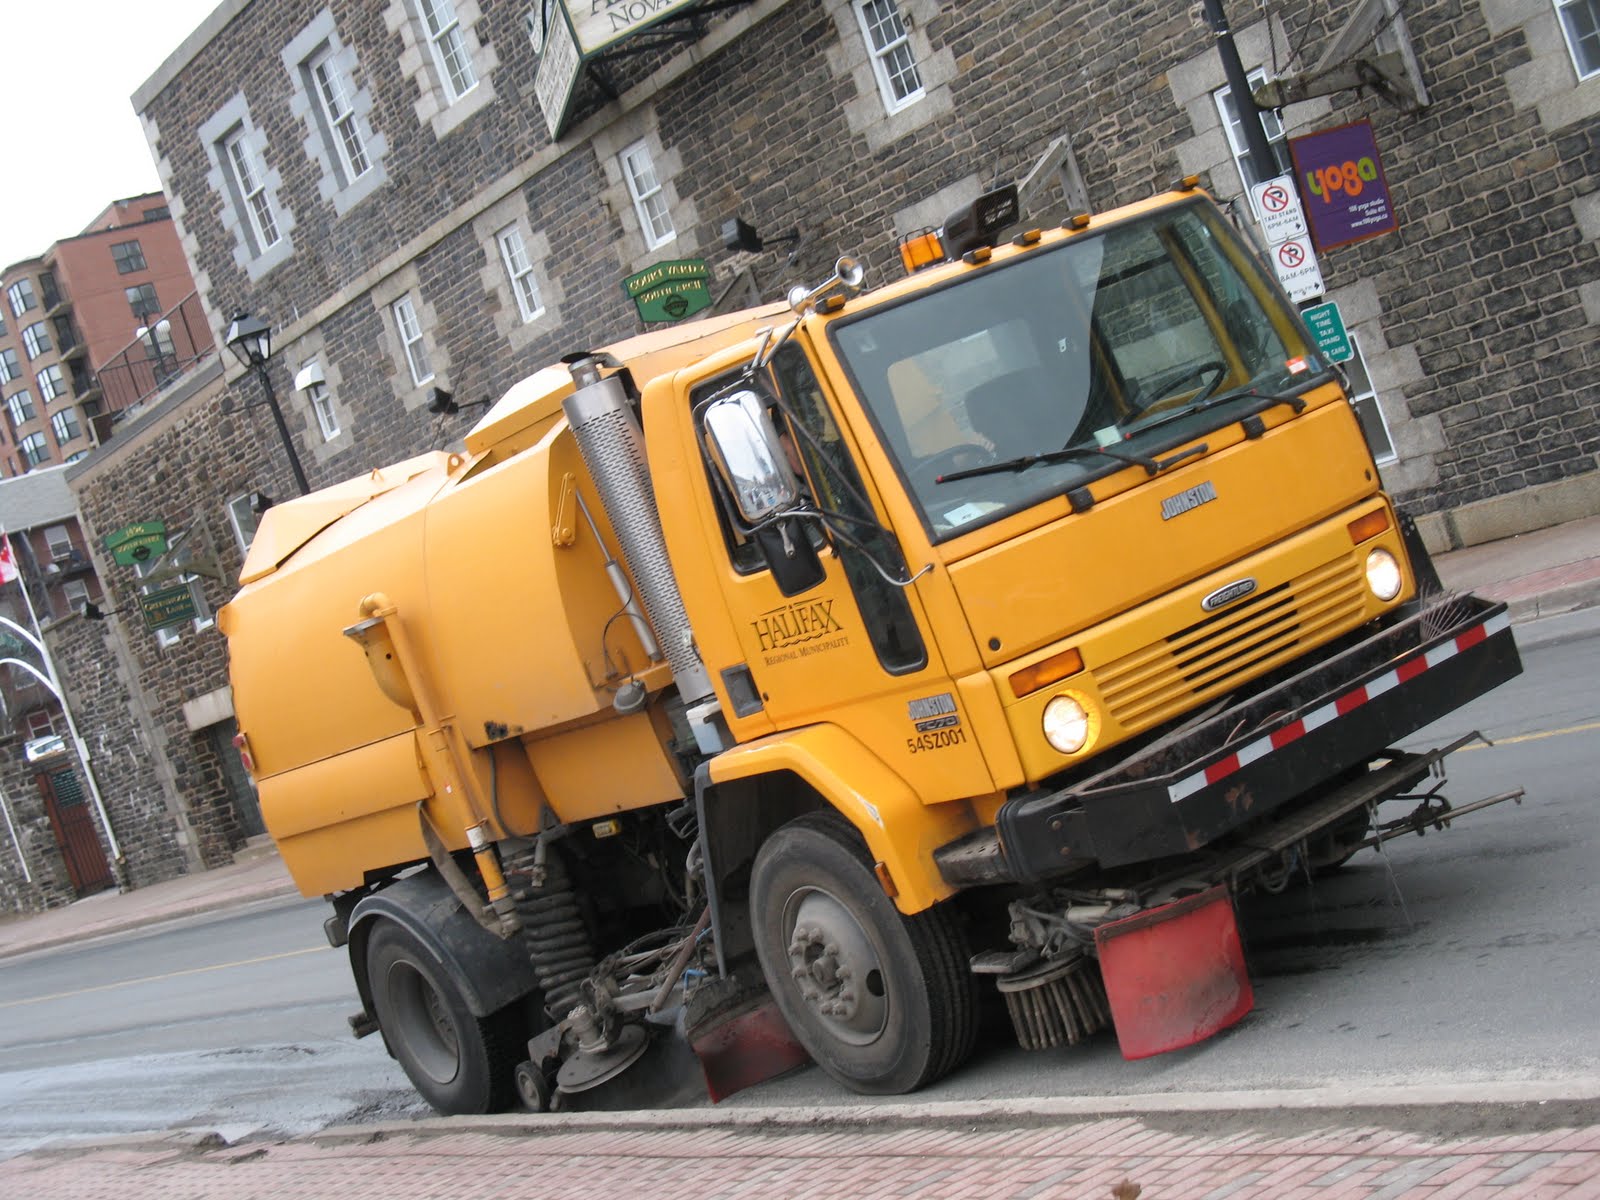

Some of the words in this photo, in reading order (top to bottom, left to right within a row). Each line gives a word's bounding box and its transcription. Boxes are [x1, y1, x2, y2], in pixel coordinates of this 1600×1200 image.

[1306, 156, 1377, 204] yoga
[1264, 213, 1278, 223] TAXI
[1277, 207, 1297, 220] STAND
[629, 268, 663, 290] COURT
[640, 287, 672, 304] SOUTH
[675, 279, 702, 293] ARCH
[1311, 309, 1330, 321] NIGHT
[1315, 318, 1332, 329] TIME
[1319, 328, 1335, 338] TAXI
[1319, 336, 1340, 347] STAND
[1160, 479, 1218, 521] JOHNSTON
[750, 598, 844, 652] HALIFAX
[764, 651, 799, 667] REGIONAL
[799, 636, 850, 658] MUNICIPALITY
[908, 693, 957, 720] JOHNSTON
[907, 728, 967, 754] 54SZ001
